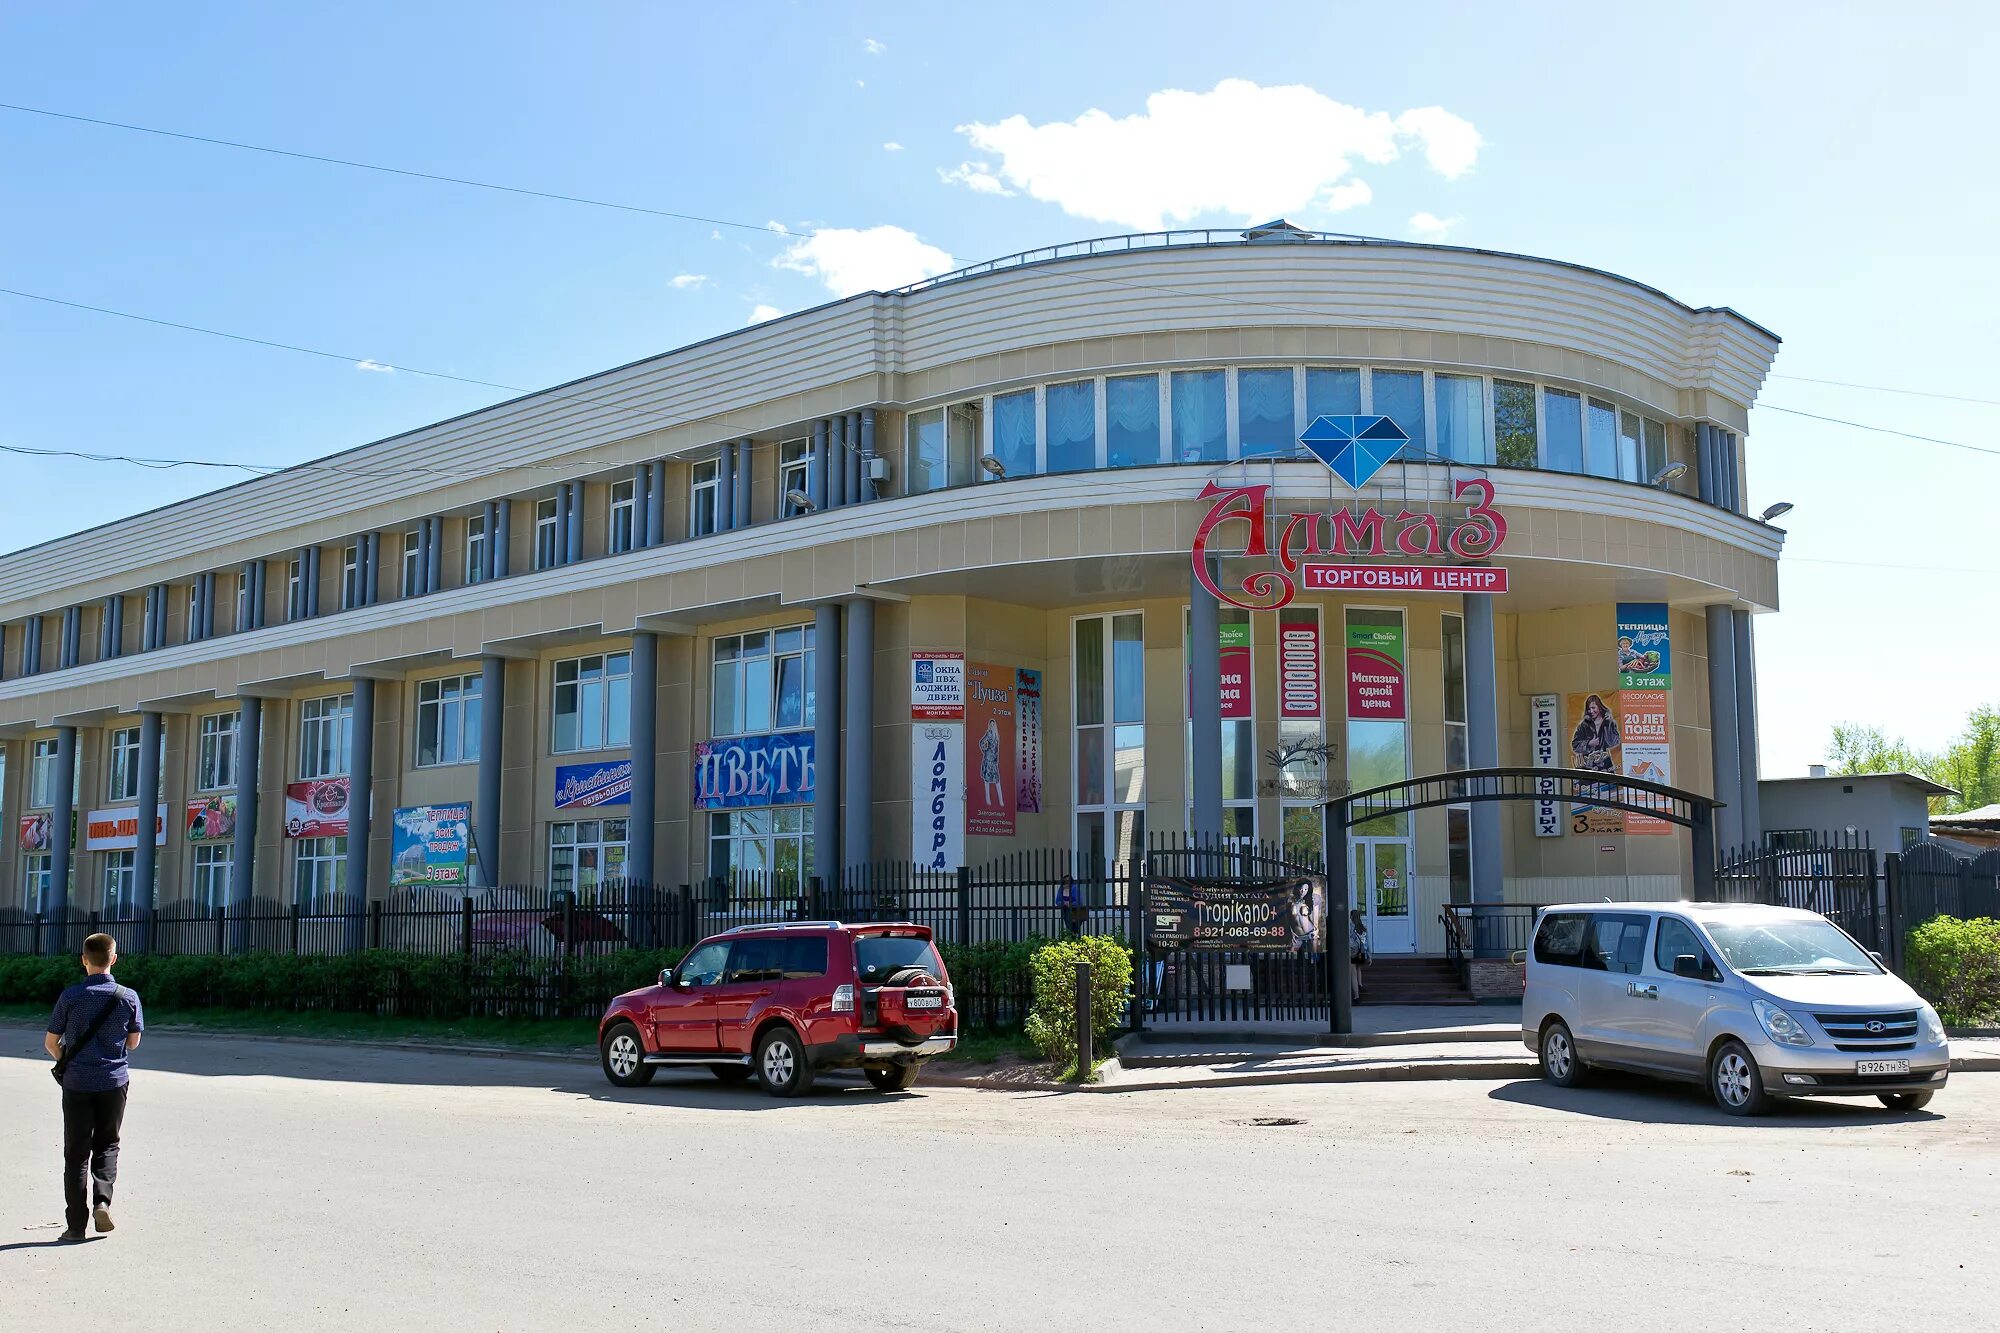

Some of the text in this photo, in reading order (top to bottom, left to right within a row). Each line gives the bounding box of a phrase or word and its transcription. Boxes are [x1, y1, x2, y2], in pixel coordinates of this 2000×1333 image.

[1313, 568, 1497, 590] ТОРГОВЫЙ ЦЕНТР
[1617, 623, 1668, 631] ТЕПЛИЦЫ
[934, 666, 961, 674] ОКНА
[935, 675, 959, 683] ПВХ,
[1352, 672, 1400, 684] Магазин
[1626, 676, 1665, 687] 3 этаж
[914, 684, 960, 692] ЛОДЖИИ,
[1358, 685, 1393, 697] одной
[927, 693, 960, 702] ДВЕРИ
[1361, 699, 1391, 709] цены
[1624, 713, 1665, 725] 20 ЛЕТ
[1624, 724, 1666, 736] ПОБЕД
[1538, 711, 1552, 765] РЕМОНТ
[931, 741, 947, 869] Ломбард
[1539, 776, 1556, 834] ОТОВЫХ
[426, 807, 468, 822] ТЕПЛИЦЫ
[88, 820, 116, 839] ПЯТЬ
[1573, 814, 1590, 834] 3
[434, 828, 455, 839] ОФИС
[429, 841, 460, 854] ПРОДАЖ
[426, 865, 460, 881] 3 этаж
[1192, 892, 1231, 901] СТУДИЯ
[1193, 926, 1285, 937] 8-921-068-69-88
[1158, 940, 1179, 948] 10-20
[1897, 1061, 1906, 1069] 35
